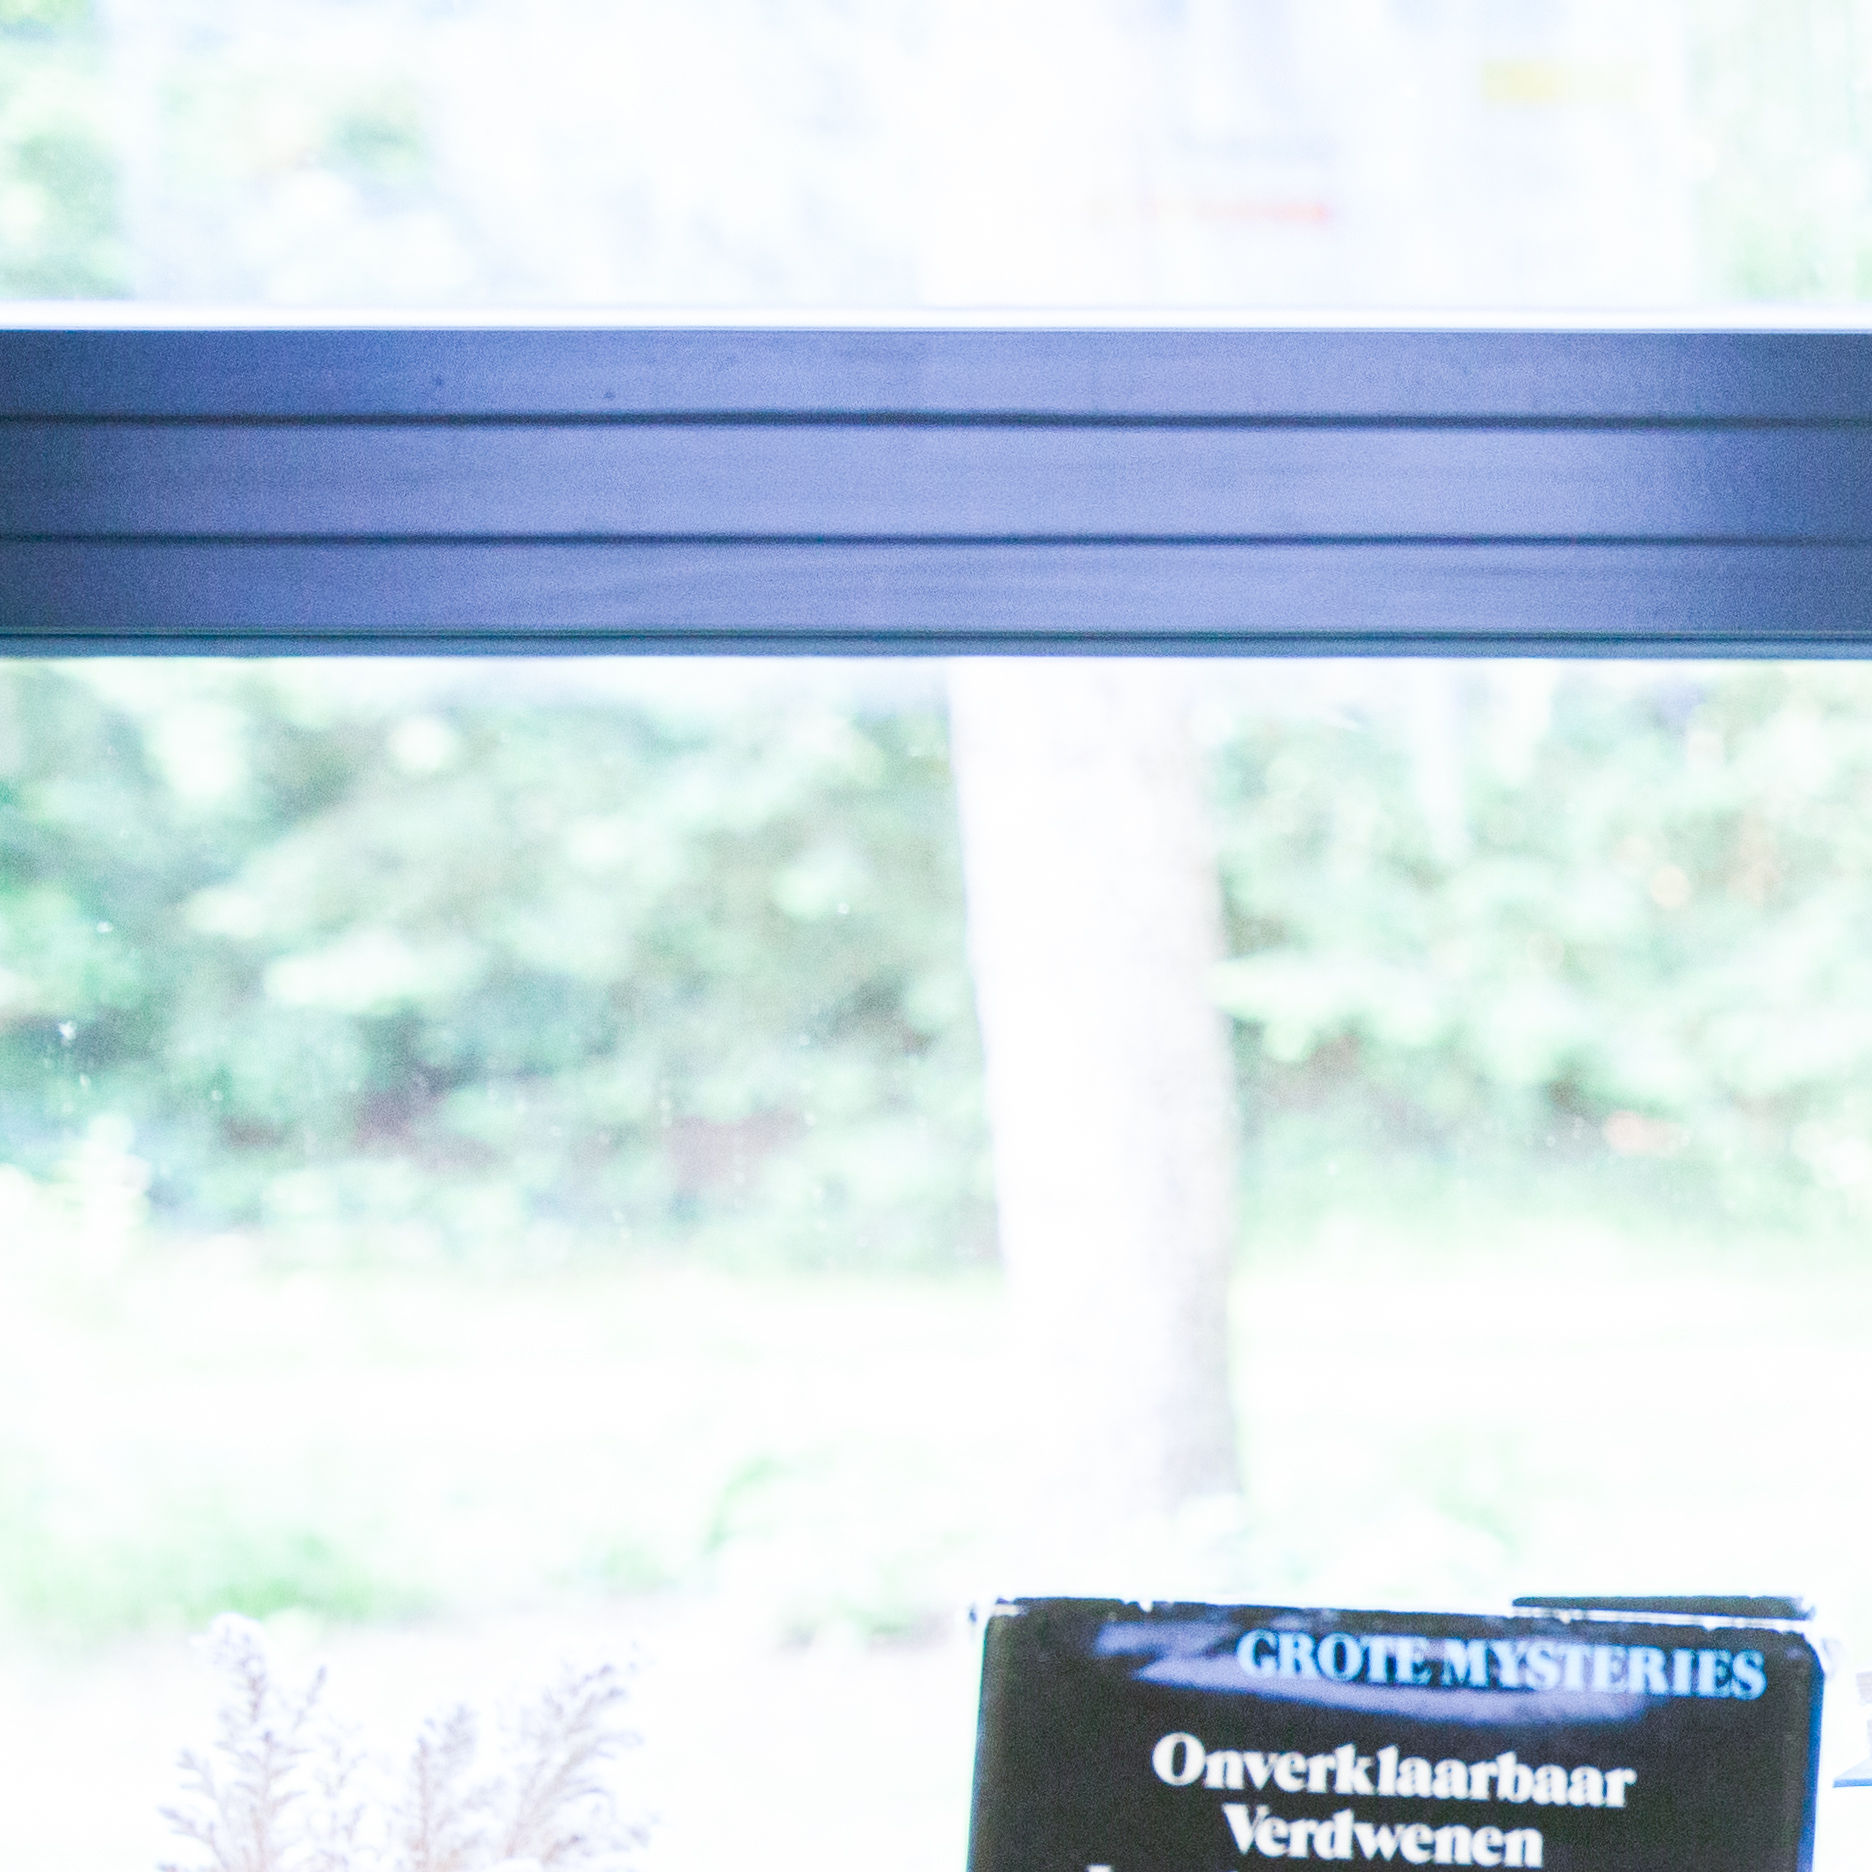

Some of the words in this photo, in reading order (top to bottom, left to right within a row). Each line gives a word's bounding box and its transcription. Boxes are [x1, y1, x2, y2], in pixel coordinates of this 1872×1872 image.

[1237, 1631, 1431, 1685] GROTE
[1441, 1636, 1766, 1700] MYSTERIES
[1153, 1732, 1636, 1807] Onverklaarbaar
[1221, 1804, 1545, 1870] Verdwenen
